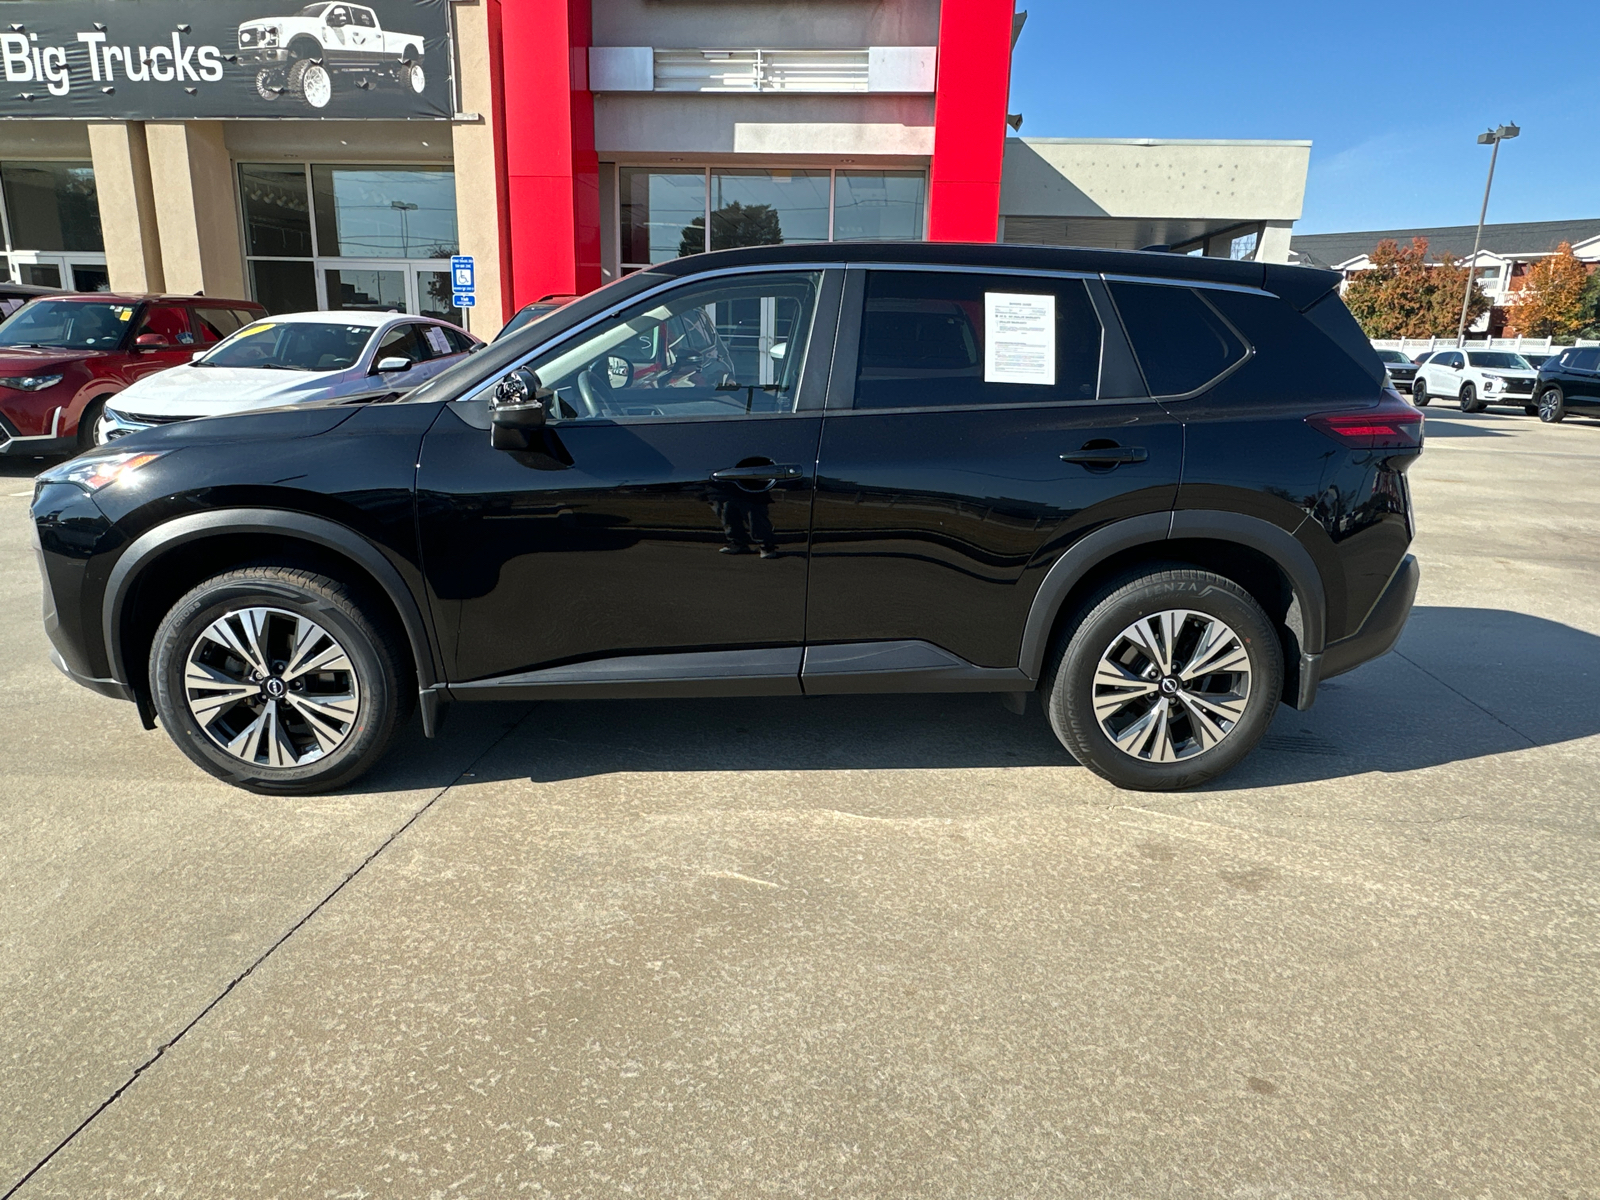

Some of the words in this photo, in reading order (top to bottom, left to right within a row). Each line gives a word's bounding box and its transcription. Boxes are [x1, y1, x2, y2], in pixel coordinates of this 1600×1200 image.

[0, 33, 70, 96] Big
[77, 31, 224, 82] Trucks
[175, 601, 202, 628] CROSS
